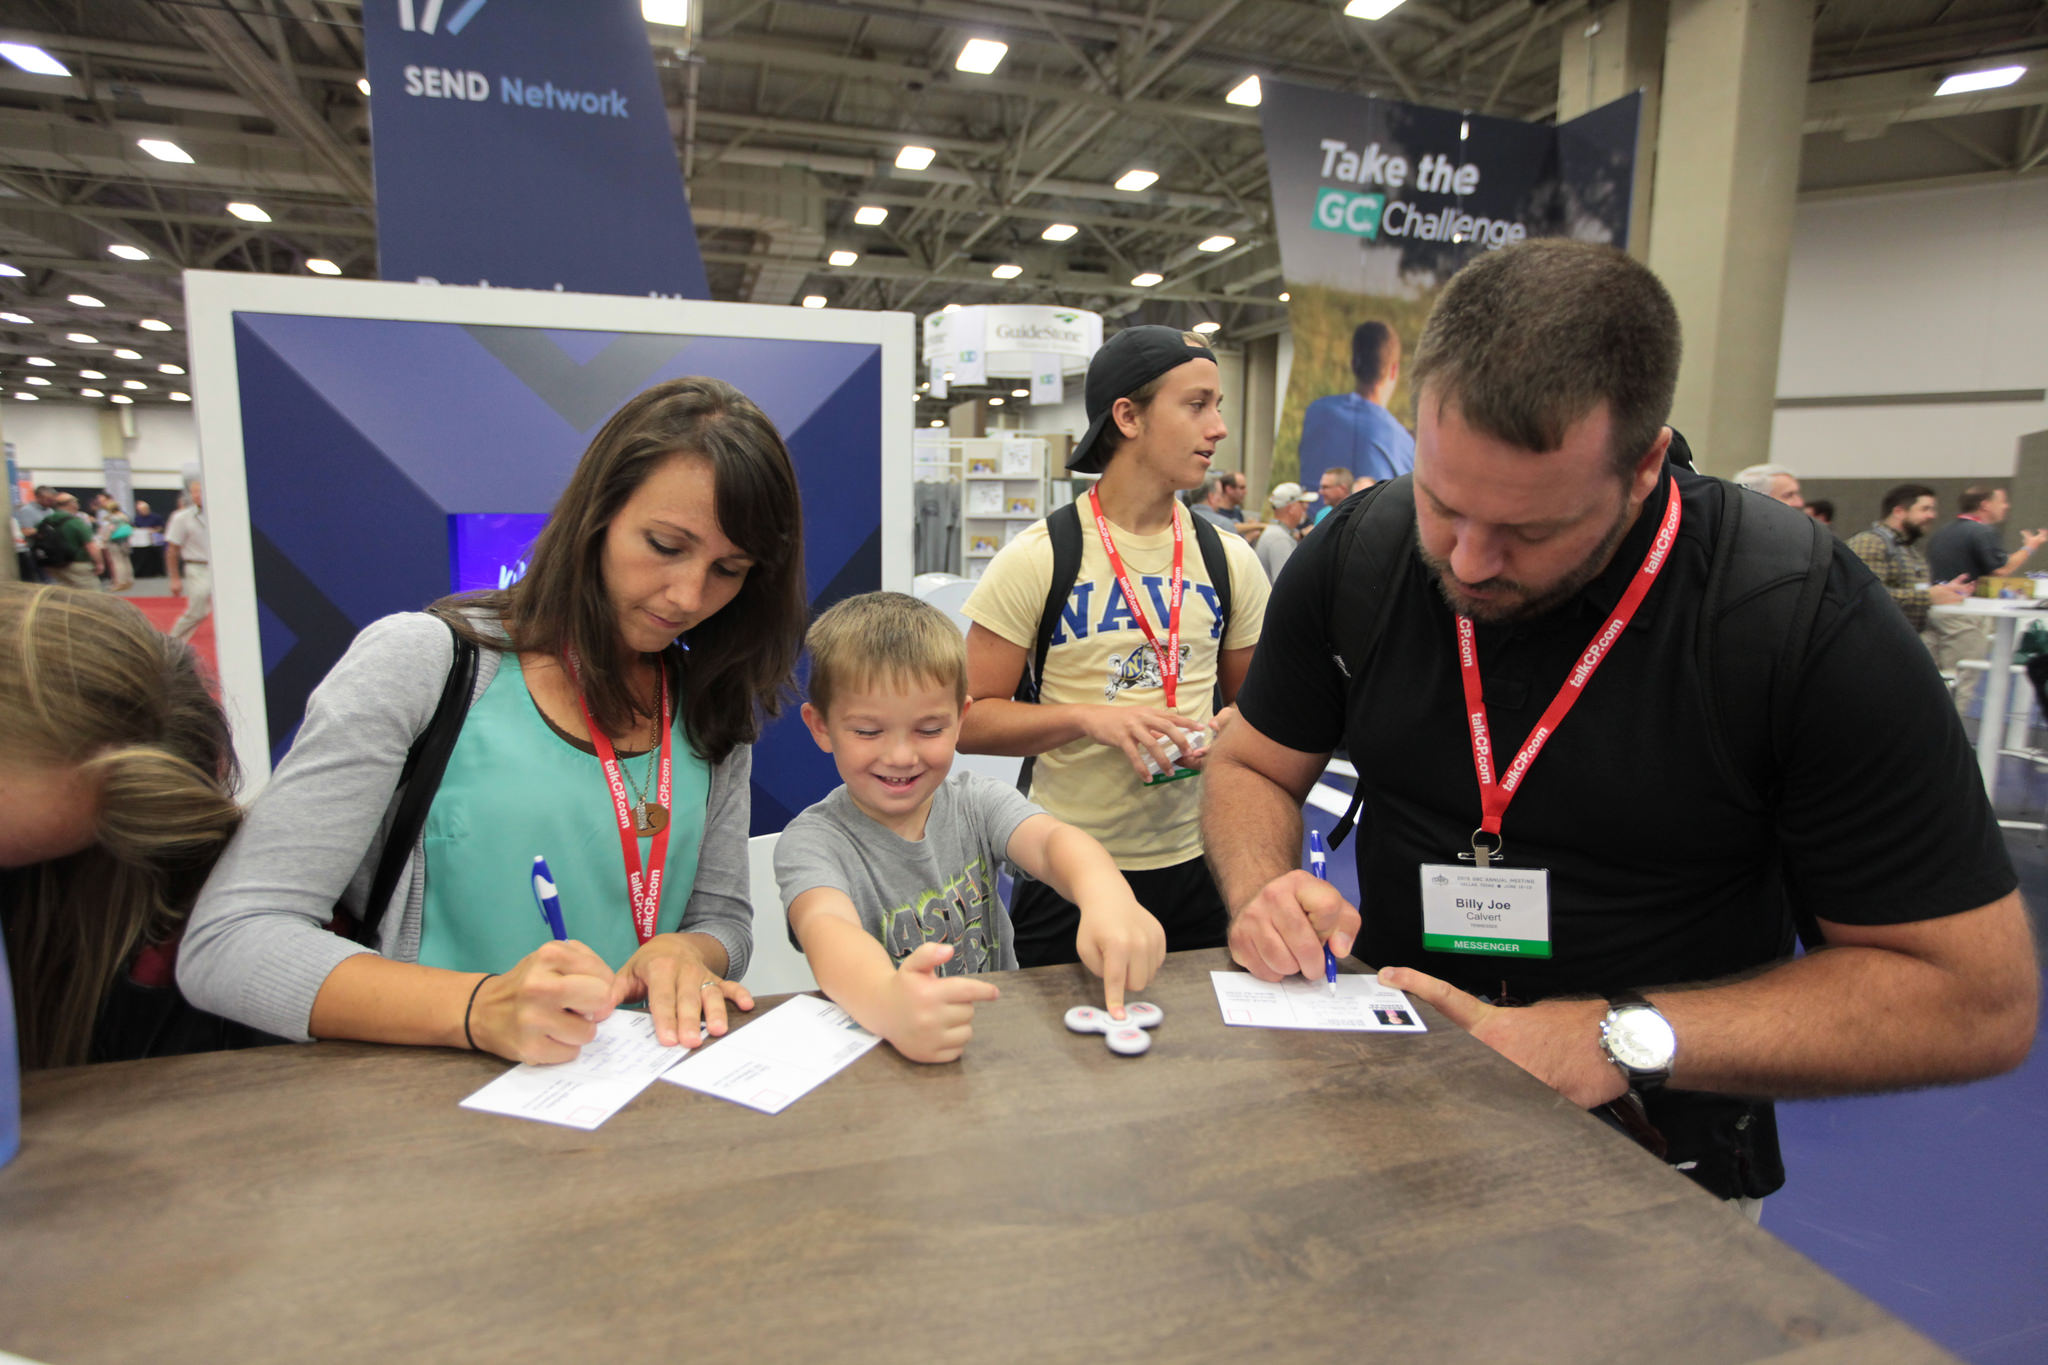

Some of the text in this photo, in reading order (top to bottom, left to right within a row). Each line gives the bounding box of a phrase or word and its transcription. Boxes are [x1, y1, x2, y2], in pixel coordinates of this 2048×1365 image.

[404, 64, 629, 118] SEND Network
[1320, 138, 1480, 195] Take the
[1317, 192, 1527, 250] GC Challenge
[1097, 515, 1115, 554] talkCP.com
[1645, 501, 1678, 575] talkCP.com
[1120, 576, 1141, 617] talkCP.com
[1172, 566, 1182, 607] talkCP.com
[1169, 633, 1177, 675] talkCP.com
[1459, 616, 1472, 667] CP.com
[1570, 618, 1623, 688] talkCP.com
[1472, 712, 1491, 785] talkCP.com
[1503, 727, 1549, 792] talkCP.com
[604, 759, 630, 829] talkCP.com
[643, 869, 661, 938] talkCP.com
[1455, 898, 1511, 911] Billy Joe
[1466, 911, 1502, 922] Calvert
[1454, 940, 1520, 952] MESSENGER
